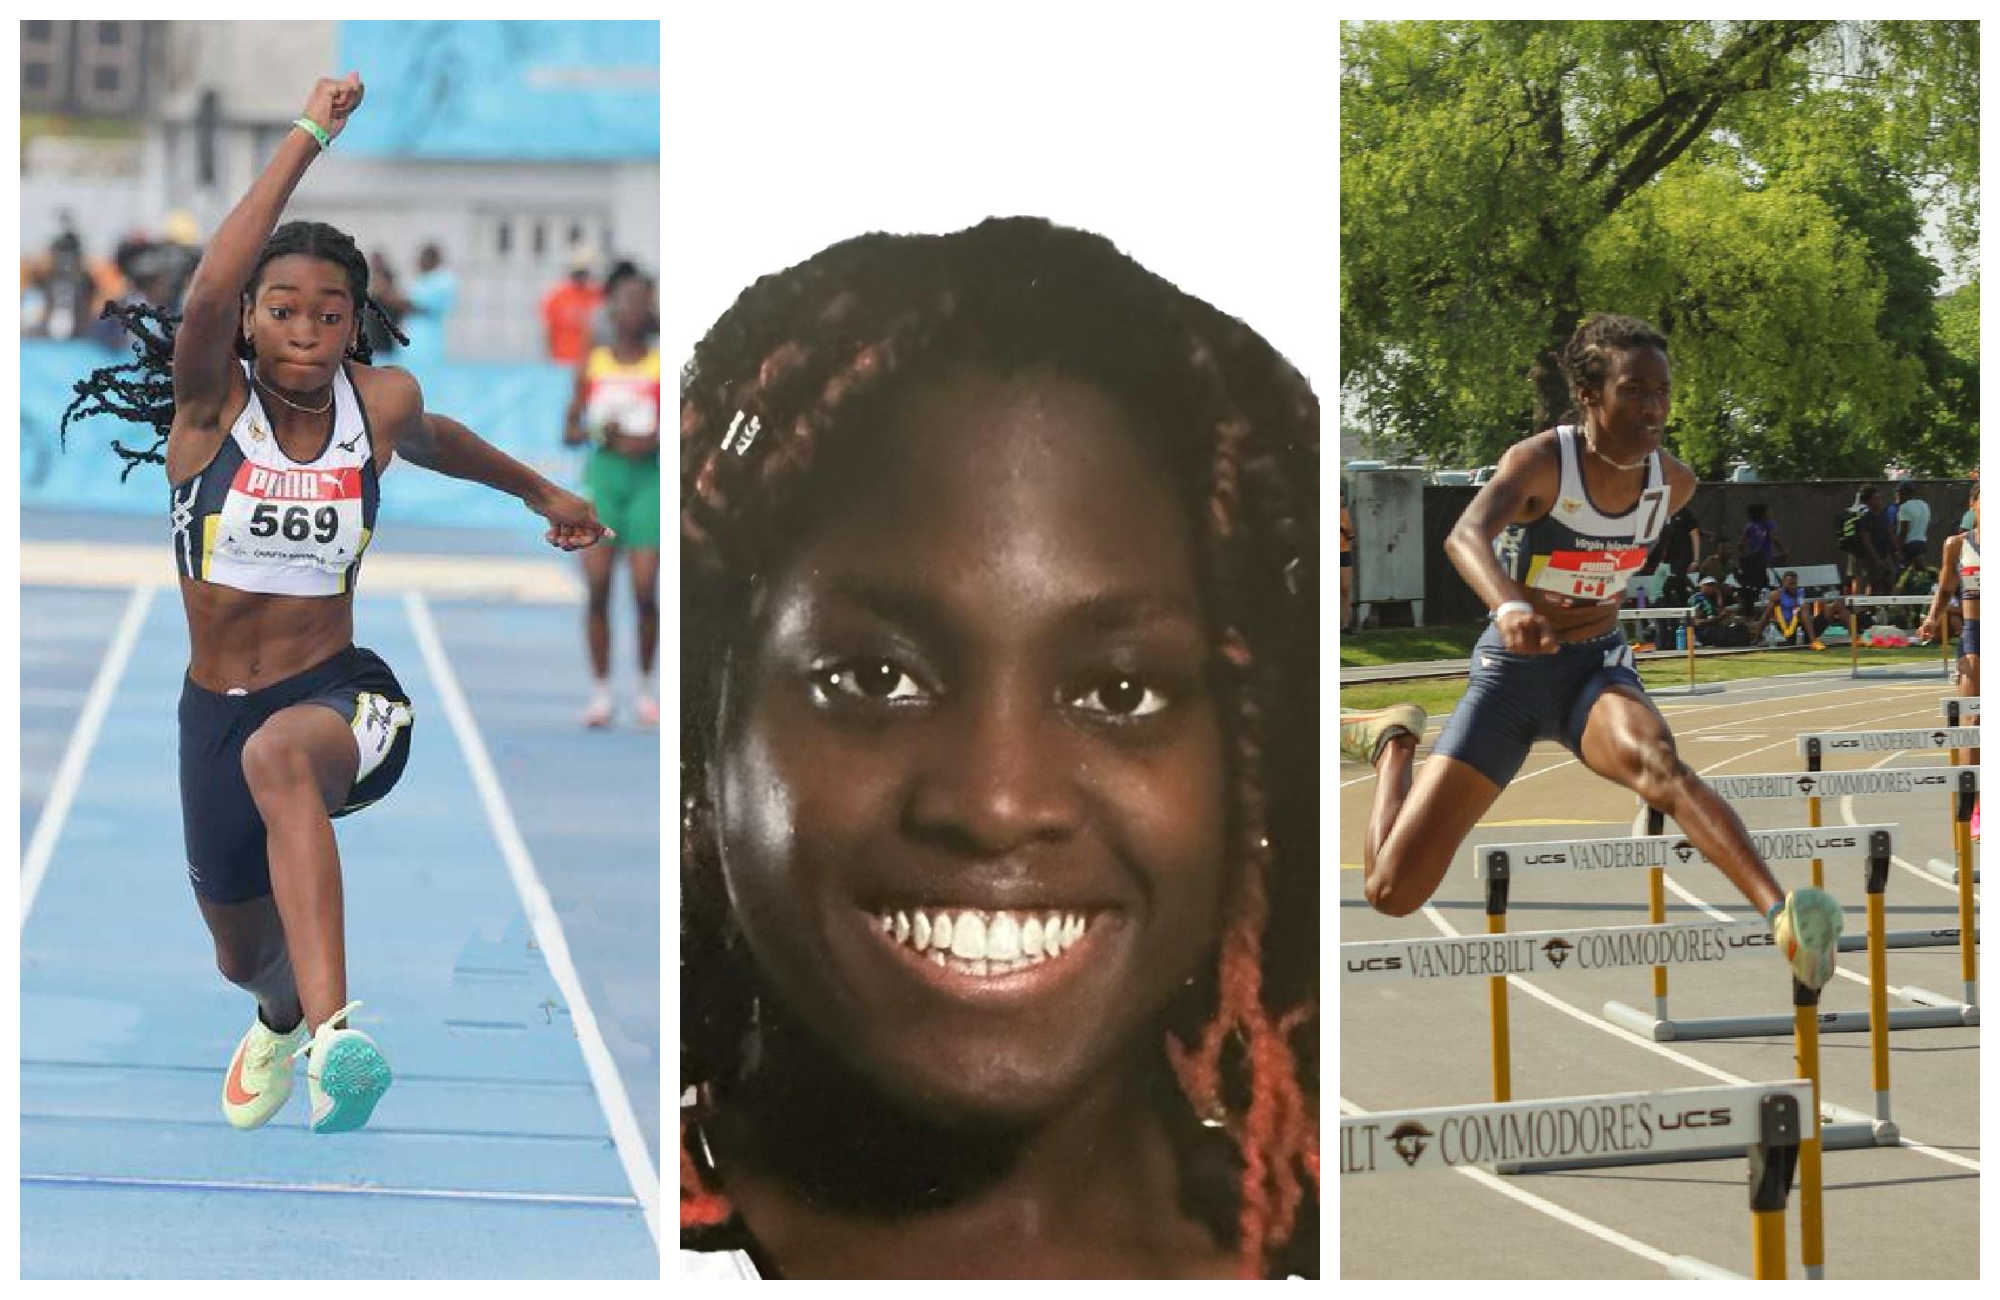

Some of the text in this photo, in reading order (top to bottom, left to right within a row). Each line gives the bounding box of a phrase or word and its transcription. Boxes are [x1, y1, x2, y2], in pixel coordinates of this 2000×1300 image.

[249, 503, 339, 544] 569
[1643, 491, 1662, 539] 7
[1818, 771, 1912, 796] COMMODORES
[1913, 775, 1947, 785] UCS
[1525, 853, 1566, 866] UCS
[1569, 841, 1669, 871] VANDERBILT
[1815, 837, 1857, 849] UCS
[1347, 928, 1776, 978] UCS VANDERBILT COMMODORES UCS
[1440, 1102, 1653, 1166] COMMODORES
[1658, 1107, 1732, 1130] UCS
